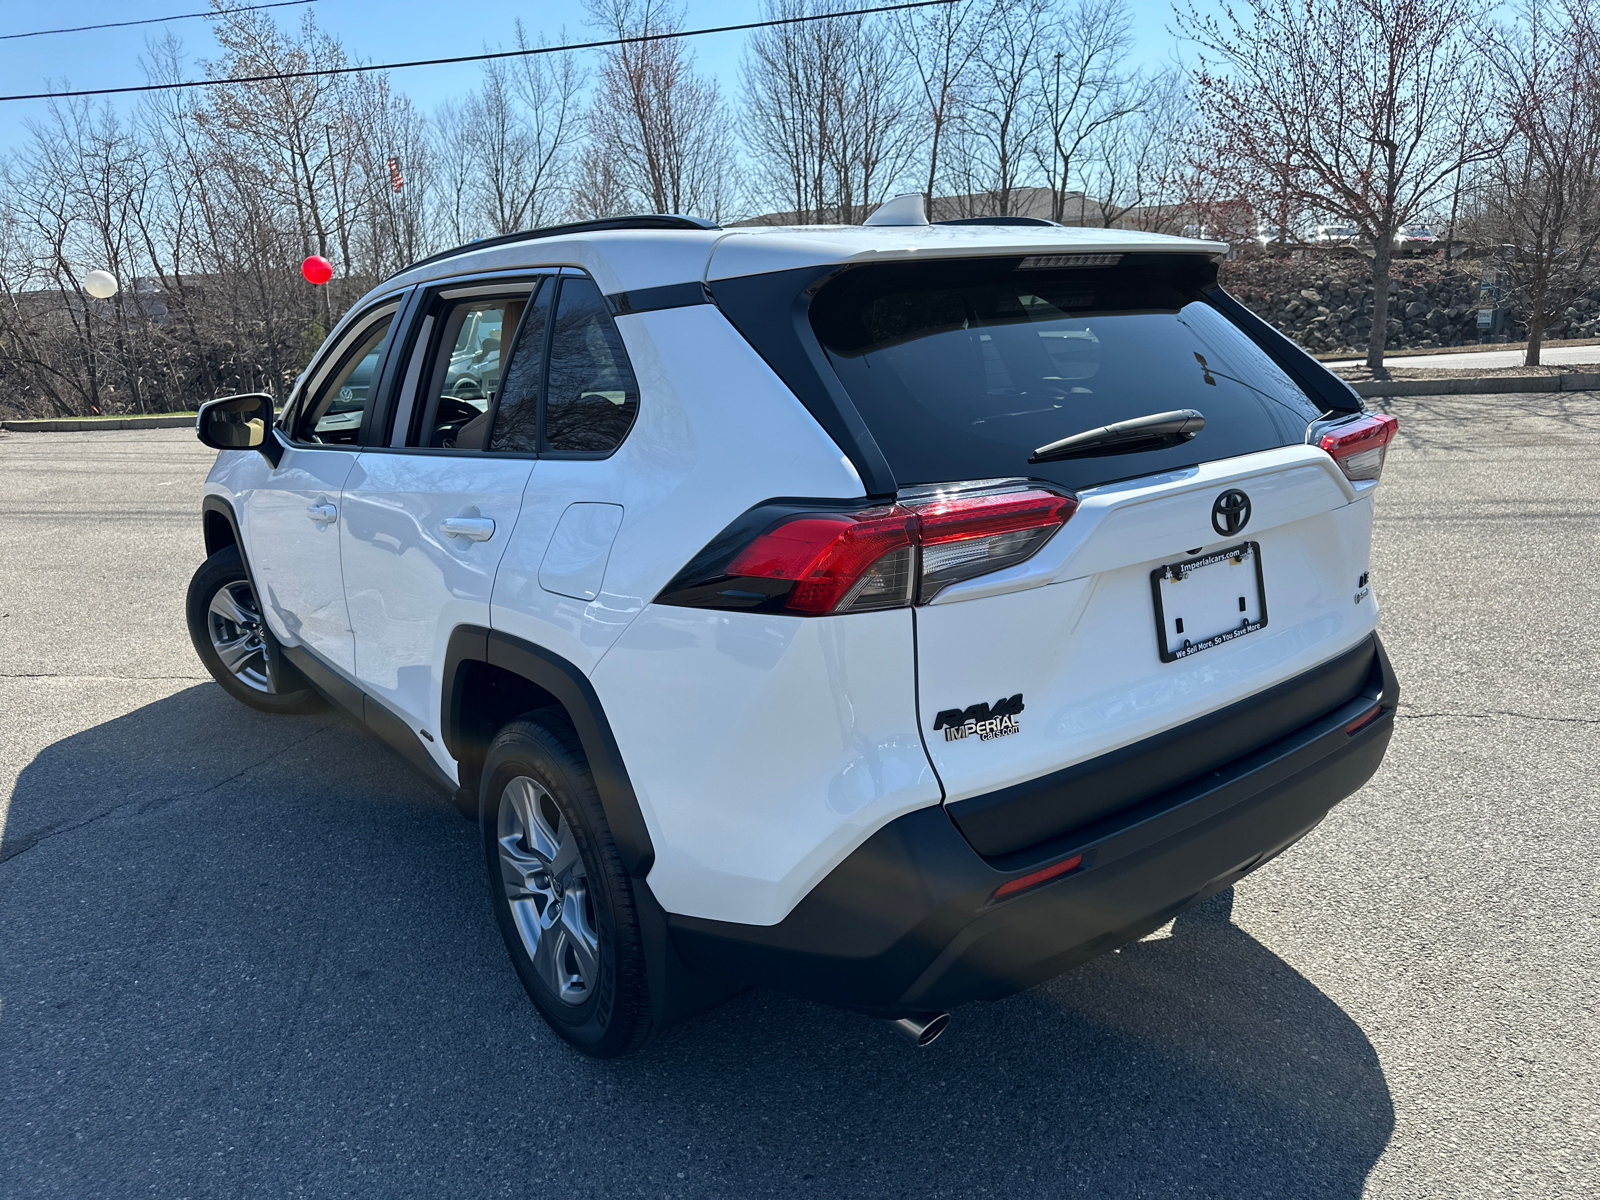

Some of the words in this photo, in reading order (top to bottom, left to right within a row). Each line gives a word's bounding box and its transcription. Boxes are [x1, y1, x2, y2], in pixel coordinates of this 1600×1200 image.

[1180, 549, 1240, 572] Imperialcars.com
[1175, 650, 1186, 659] We
[1186, 645, 1197, 655] Sell
[1198, 639, 1214, 650] More,
[1214, 636, 1222, 645] So
[1222, 632, 1234, 641] You
[1233, 628, 1247, 638] Save
[1246, 623, 1260, 633] More
[933, 693, 1025, 731] RAV4
[944, 713, 1020, 742] IMPERIAL
[980, 725, 1020, 741] cars.com
